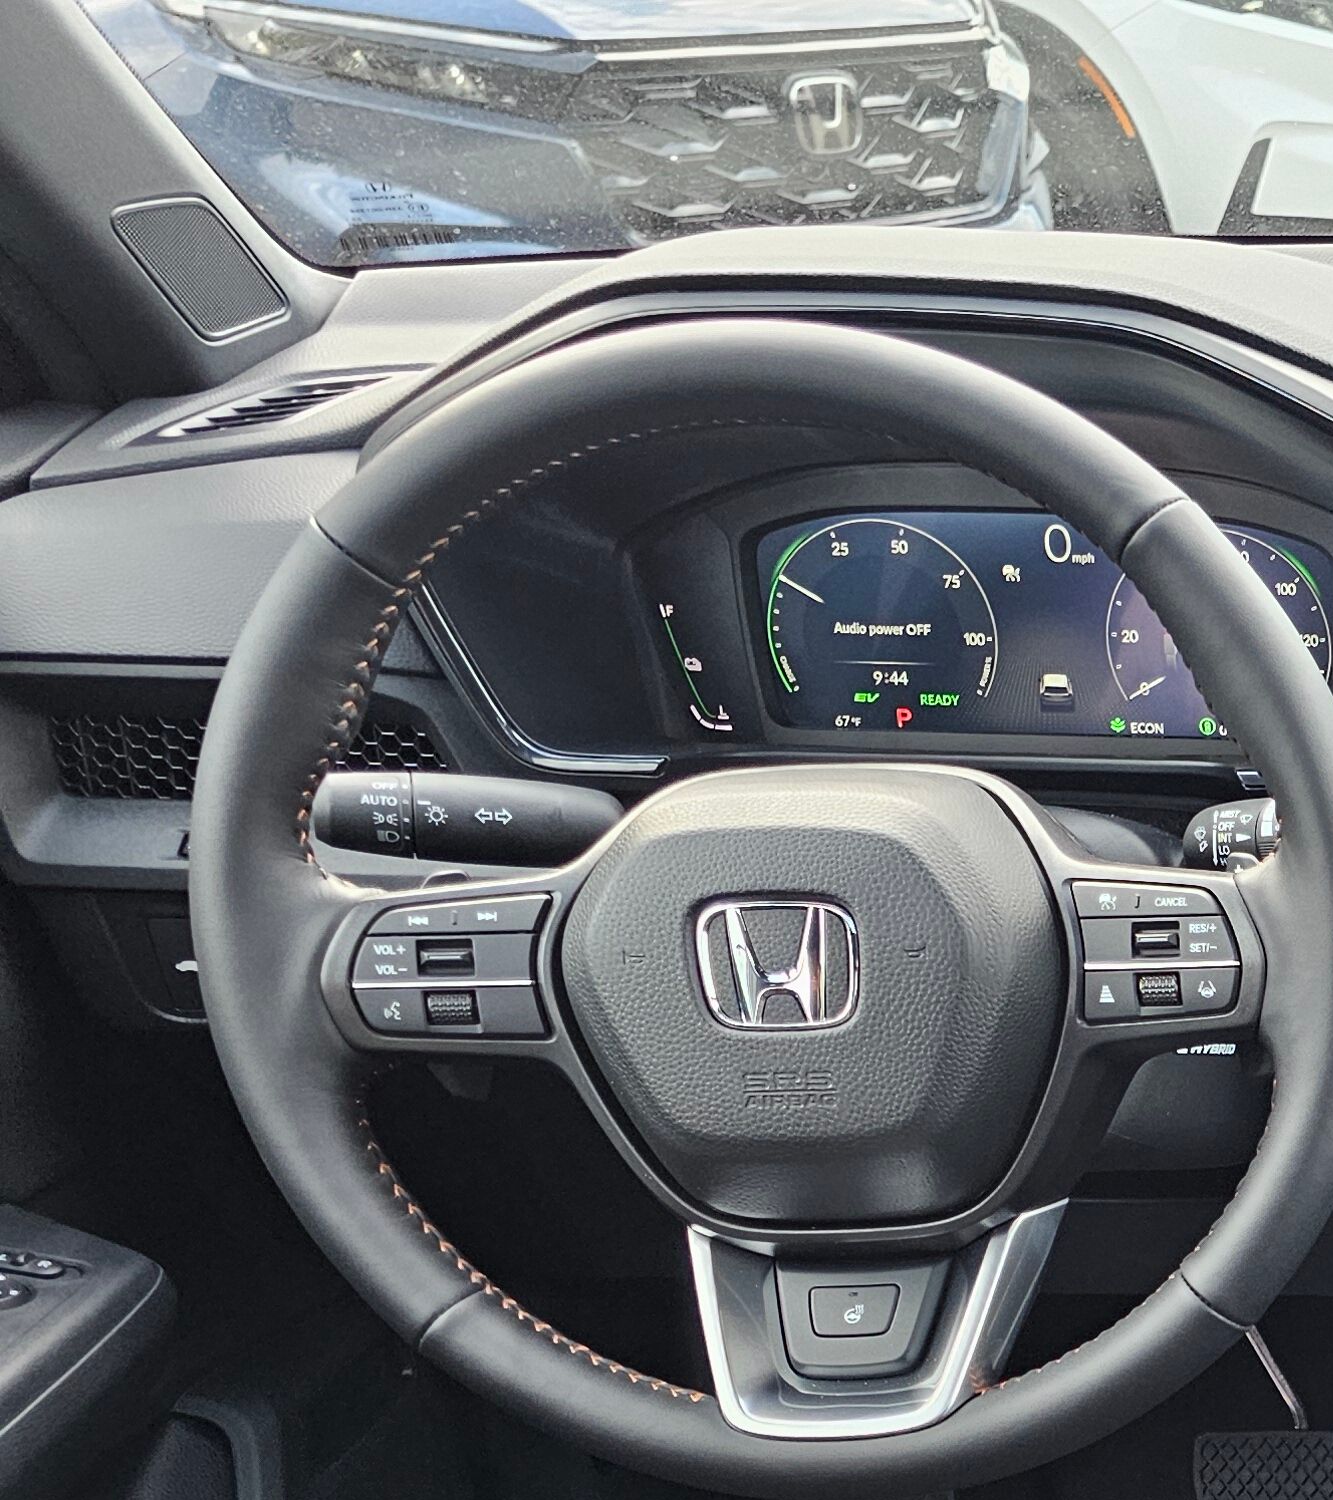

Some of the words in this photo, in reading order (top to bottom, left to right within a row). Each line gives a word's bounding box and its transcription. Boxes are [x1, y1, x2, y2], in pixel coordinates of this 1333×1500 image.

[831, 542, 848, 557] 25
[891, 540, 908, 555] 50
[1044, 524, 1072, 563] 0
[1071, 552, 1095, 566] mph
[942, 575, 960, 589] 75
[1275, 582, 1297, 596] 100
[834, 622, 867, 636] Audio
[869, 625, 904, 637] power
[906, 624, 932, 636] OFF
[963, 633, 986, 647] 100
[1121, 630, 1139, 644] 20
[872, 671, 908, 686] 9:44
[920, 694, 959, 707] READY
[896, 708, 914, 728] P
[1130, 721, 1165, 735] ECON
[360, 794, 398, 807] AUTO
[1218, 821, 1236, 832] OFF
[1218, 832, 1232, 844] INT
[1218, 845, 1230, 855] LO
[1154, 897, 1188, 907] CANCEL
